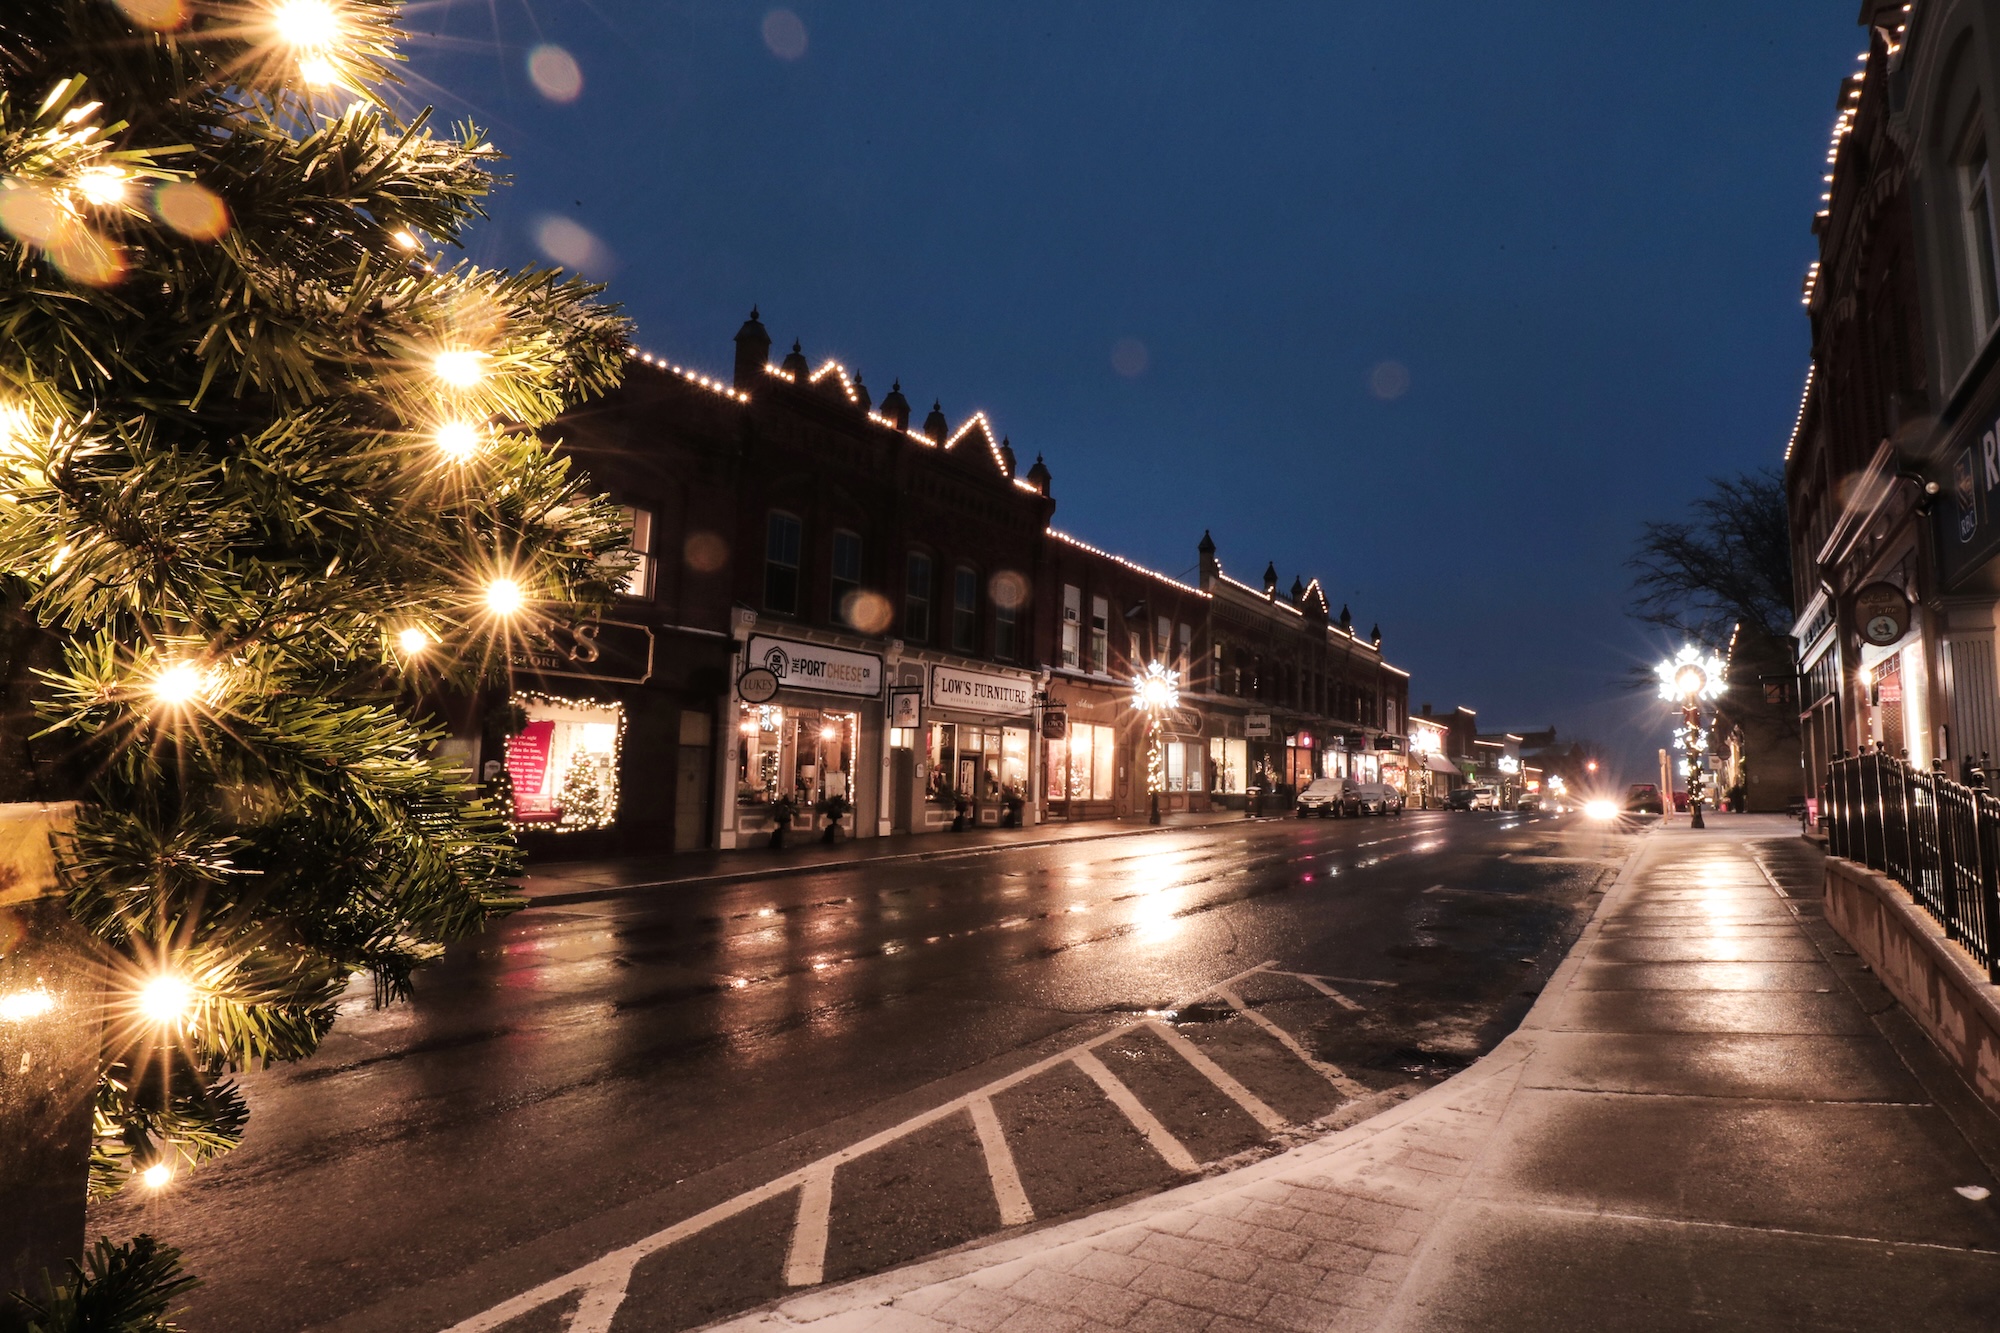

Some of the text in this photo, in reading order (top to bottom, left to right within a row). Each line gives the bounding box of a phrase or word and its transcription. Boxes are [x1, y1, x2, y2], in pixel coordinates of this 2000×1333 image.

[1961, 510, 1975, 536] RBC
[792, 658, 800, 673] THE
[800, 658, 826, 678] PORT
[827, 662, 863, 683] CHEESE
[942, 678, 1027, 704] LOW'S FURNITURE
